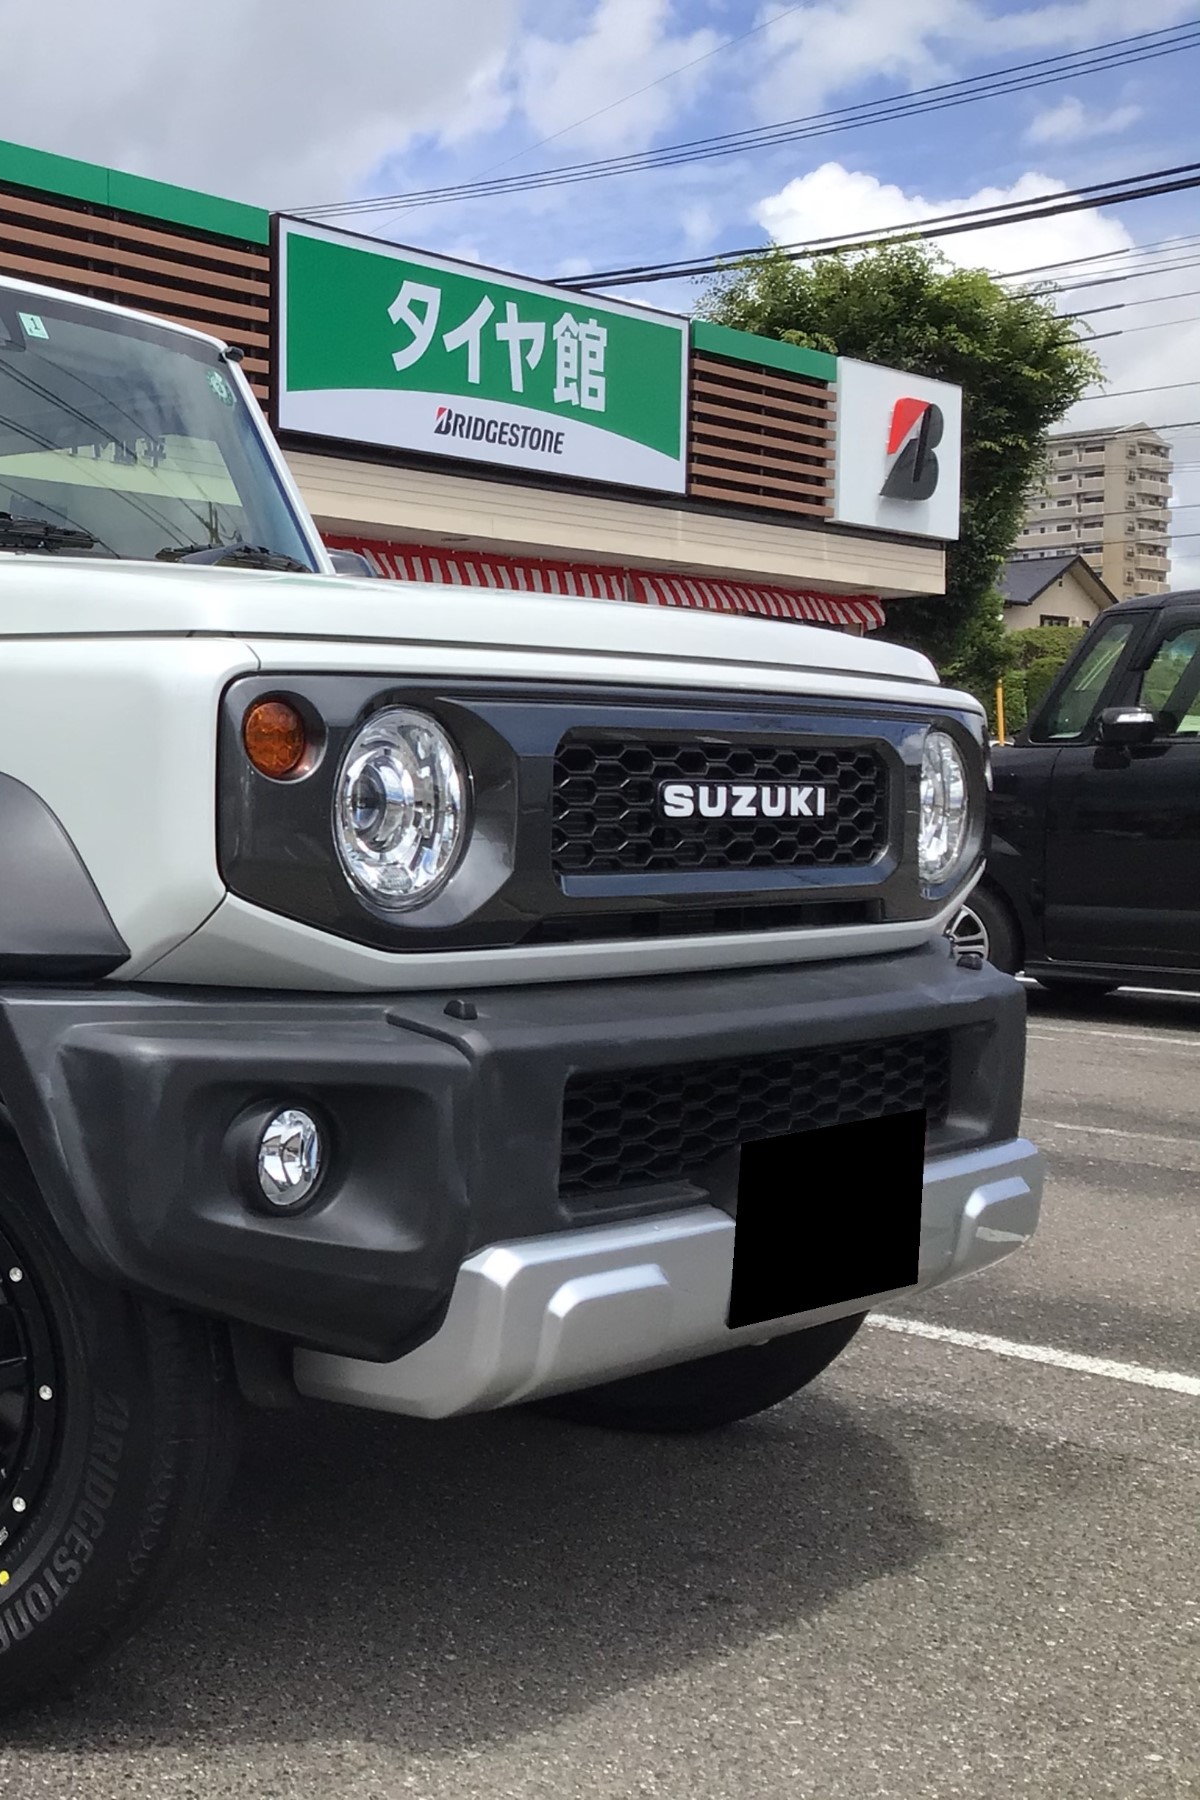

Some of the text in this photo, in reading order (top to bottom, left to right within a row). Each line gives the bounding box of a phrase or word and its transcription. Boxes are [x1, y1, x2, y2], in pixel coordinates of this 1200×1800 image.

[386, 279, 608, 413] タイヤ館
[433, 406, 565, 455] BRIDGESTONE
[664, 784, 826, 818] SUZUKI
